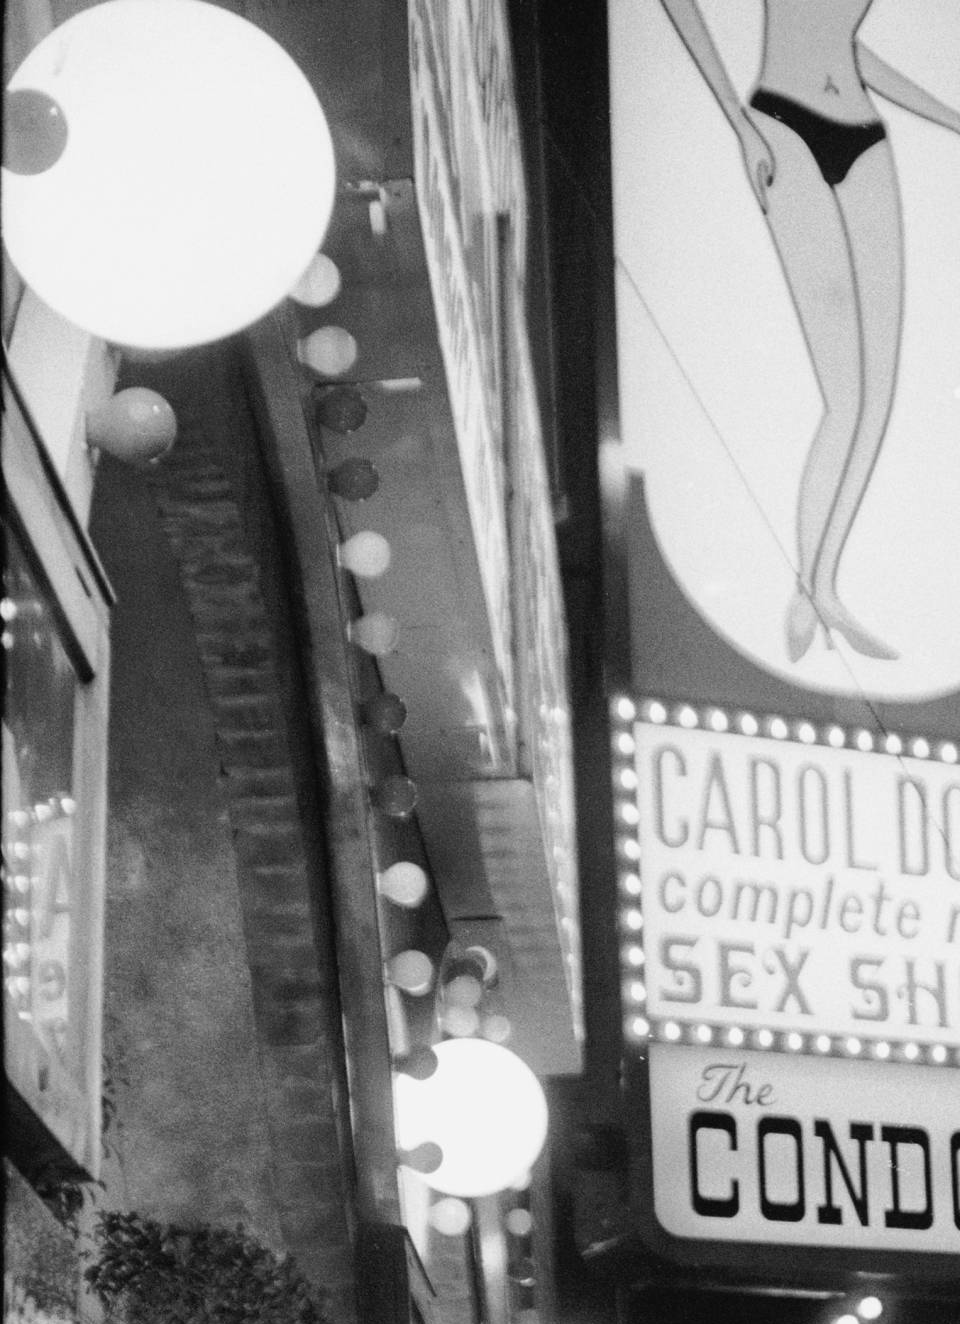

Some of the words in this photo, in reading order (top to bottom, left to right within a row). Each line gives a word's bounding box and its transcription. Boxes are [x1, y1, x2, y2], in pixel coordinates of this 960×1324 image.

[652, 743, 877, 871] CAROL
[657, 870, 922, 939] complete
[658, 935, 814, 1017] SEX
[697, 1062, 776, 1107] The
